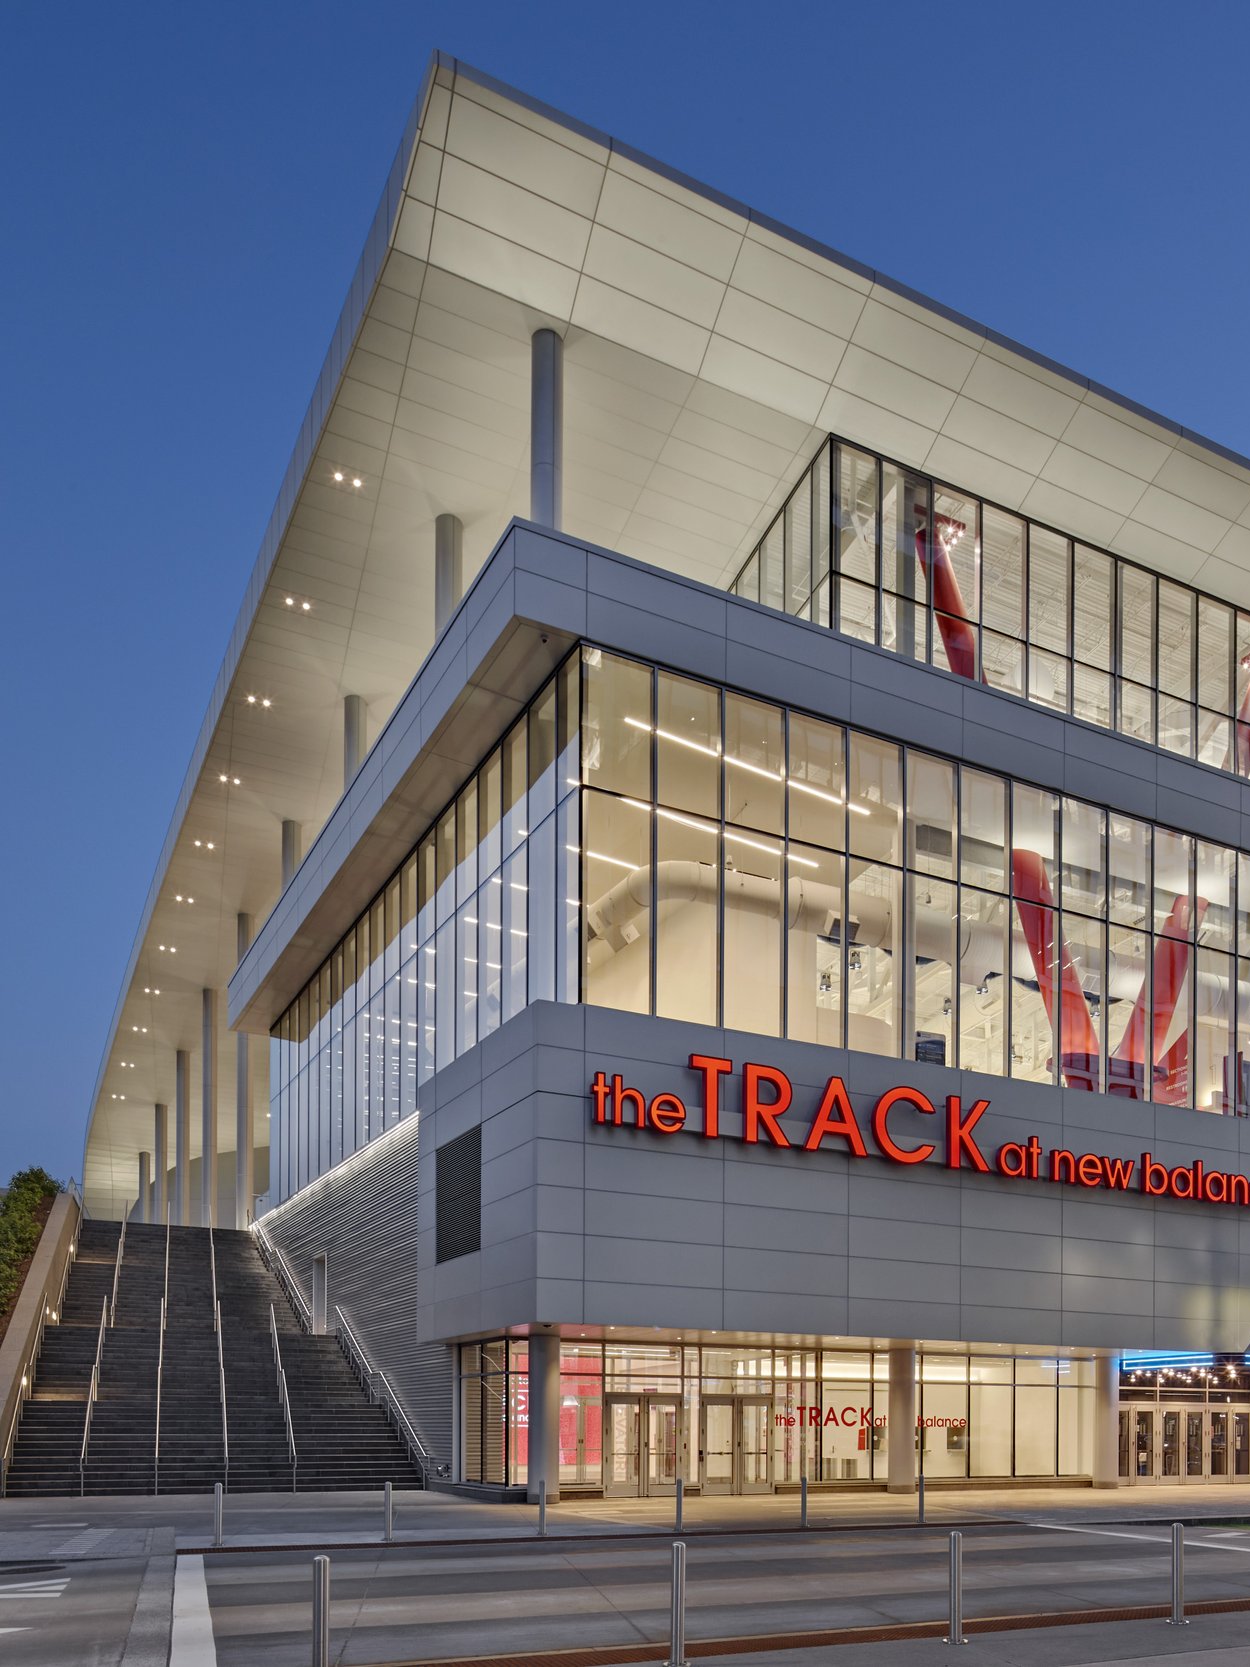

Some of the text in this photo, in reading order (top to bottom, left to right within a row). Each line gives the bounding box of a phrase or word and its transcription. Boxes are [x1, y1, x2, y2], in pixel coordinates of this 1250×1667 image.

[590, 1071, 687, 1134] the
[688, 1053, 991, 1173] TRACK
[996, 1135, 1042, 1179] at
[1050, 1149, 1135, 1190] new
[774, 1406, 967, 1428] the TRACK at balance
